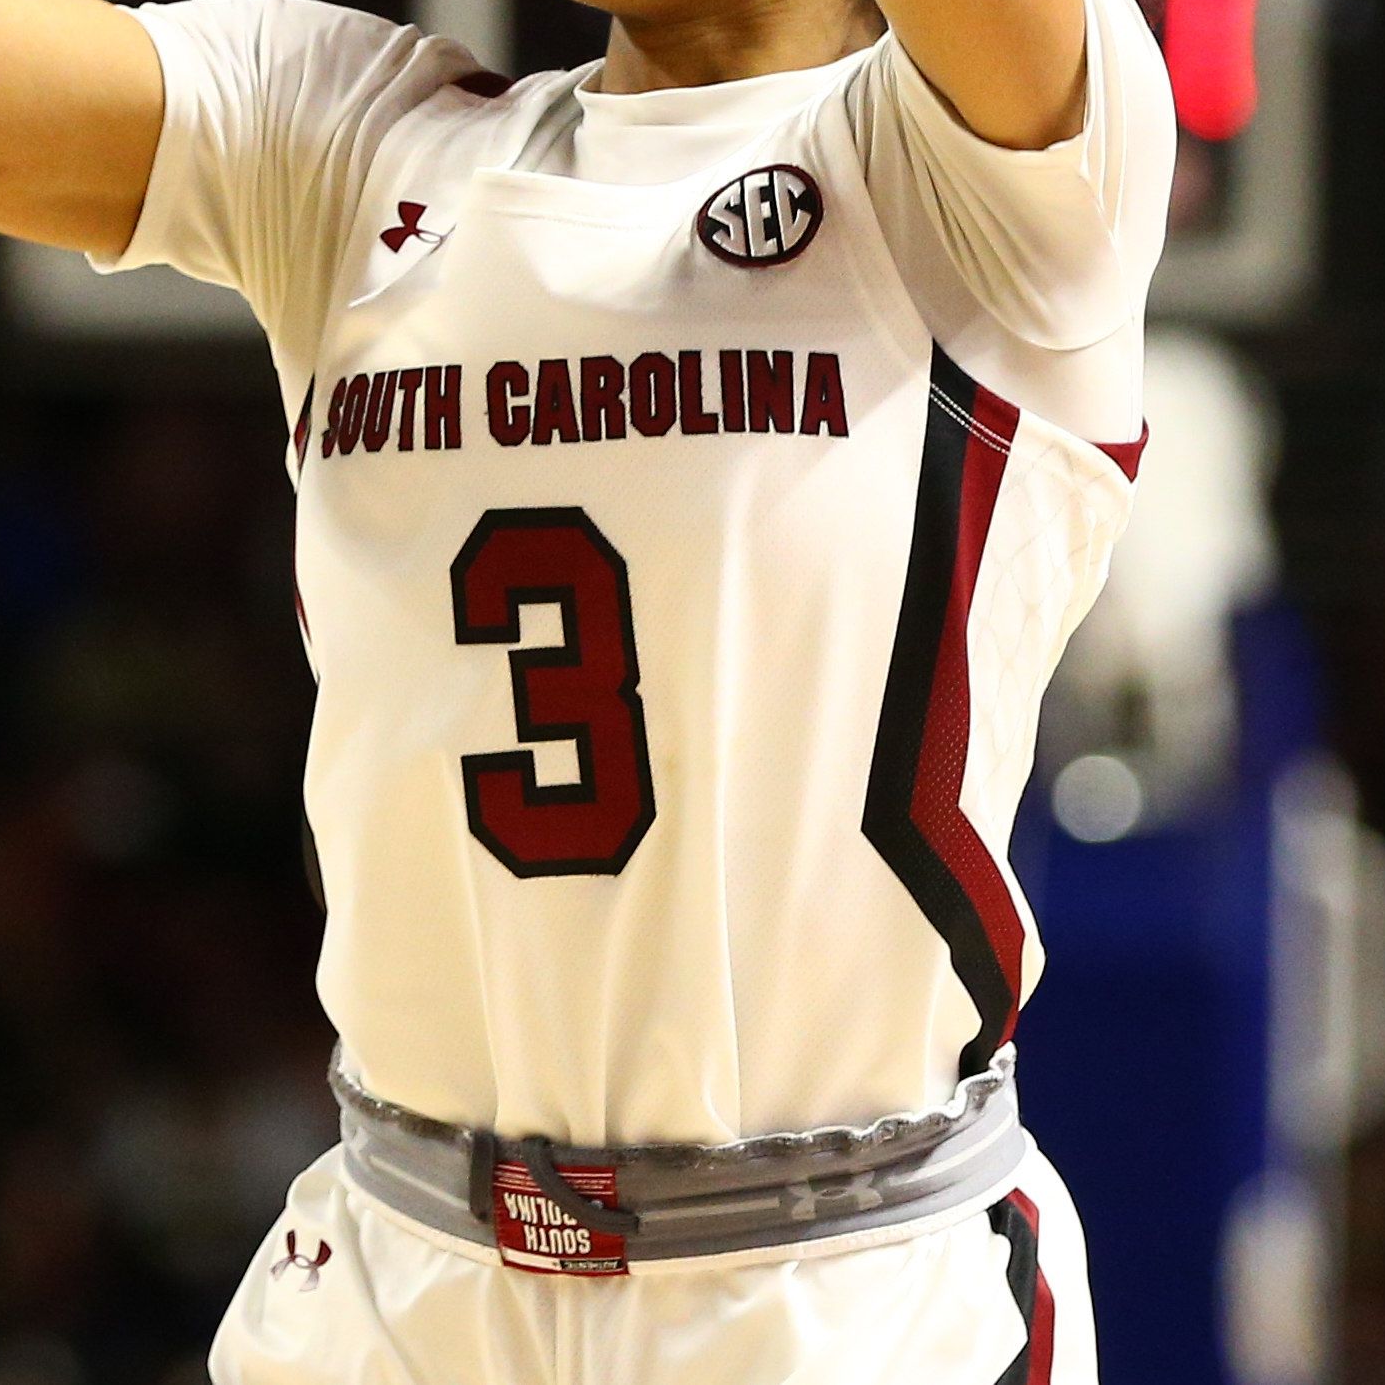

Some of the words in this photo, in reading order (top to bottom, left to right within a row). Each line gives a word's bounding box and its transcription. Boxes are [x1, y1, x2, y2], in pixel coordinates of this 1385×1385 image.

[707, 169, 813, 257] SEC
[321, 364, 463, 459] SOUTH
[485, 349, 849, 447] CAROLINA
[450, 506, 657, 879] 3
[503, 1191, 578, 1226] OLINA
[523, 1224, 592, 1255] SOUTH
